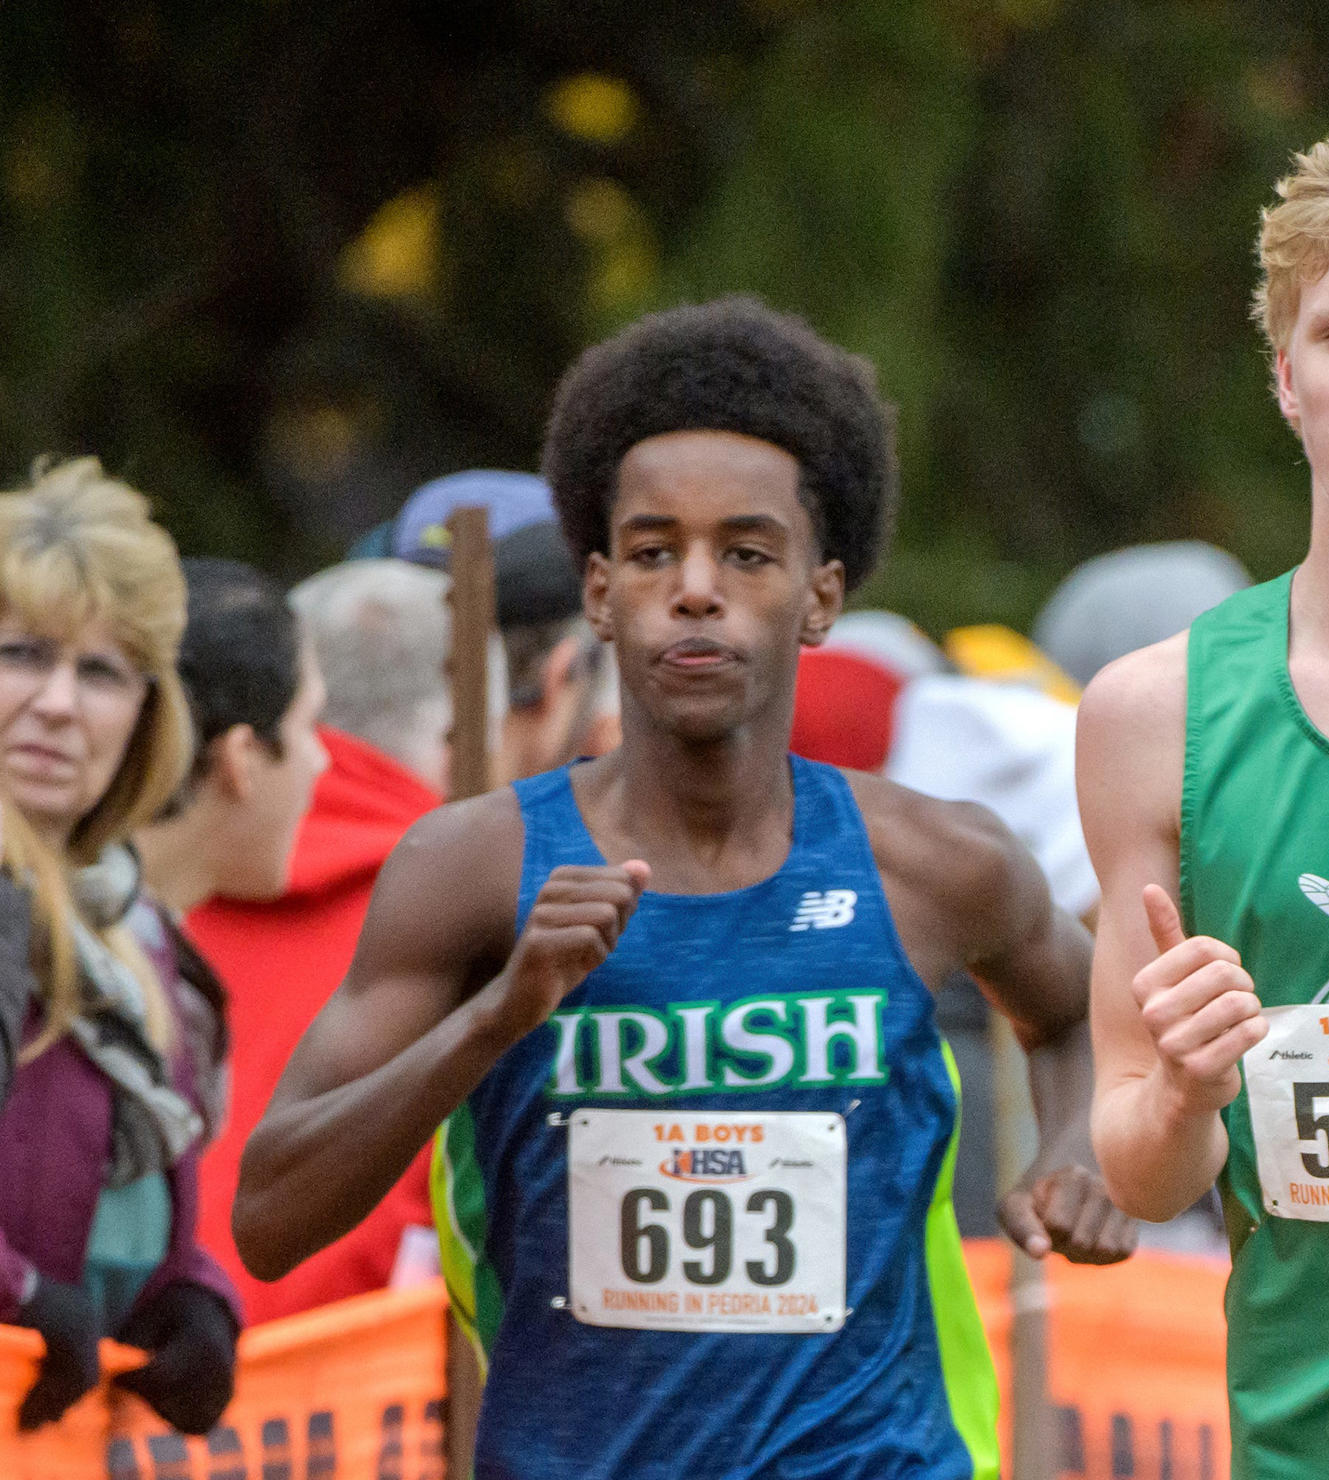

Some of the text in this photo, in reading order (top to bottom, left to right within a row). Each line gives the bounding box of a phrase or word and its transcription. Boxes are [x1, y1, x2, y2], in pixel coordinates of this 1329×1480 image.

[552, 991, 886, 1095] IRISH
[653, 1124, 765, 1144] 1A BOYS
[620, 1186, 797, 1287] 693
[602, 1288, 820, 1316] RUNNING IN PEORIA 2024
